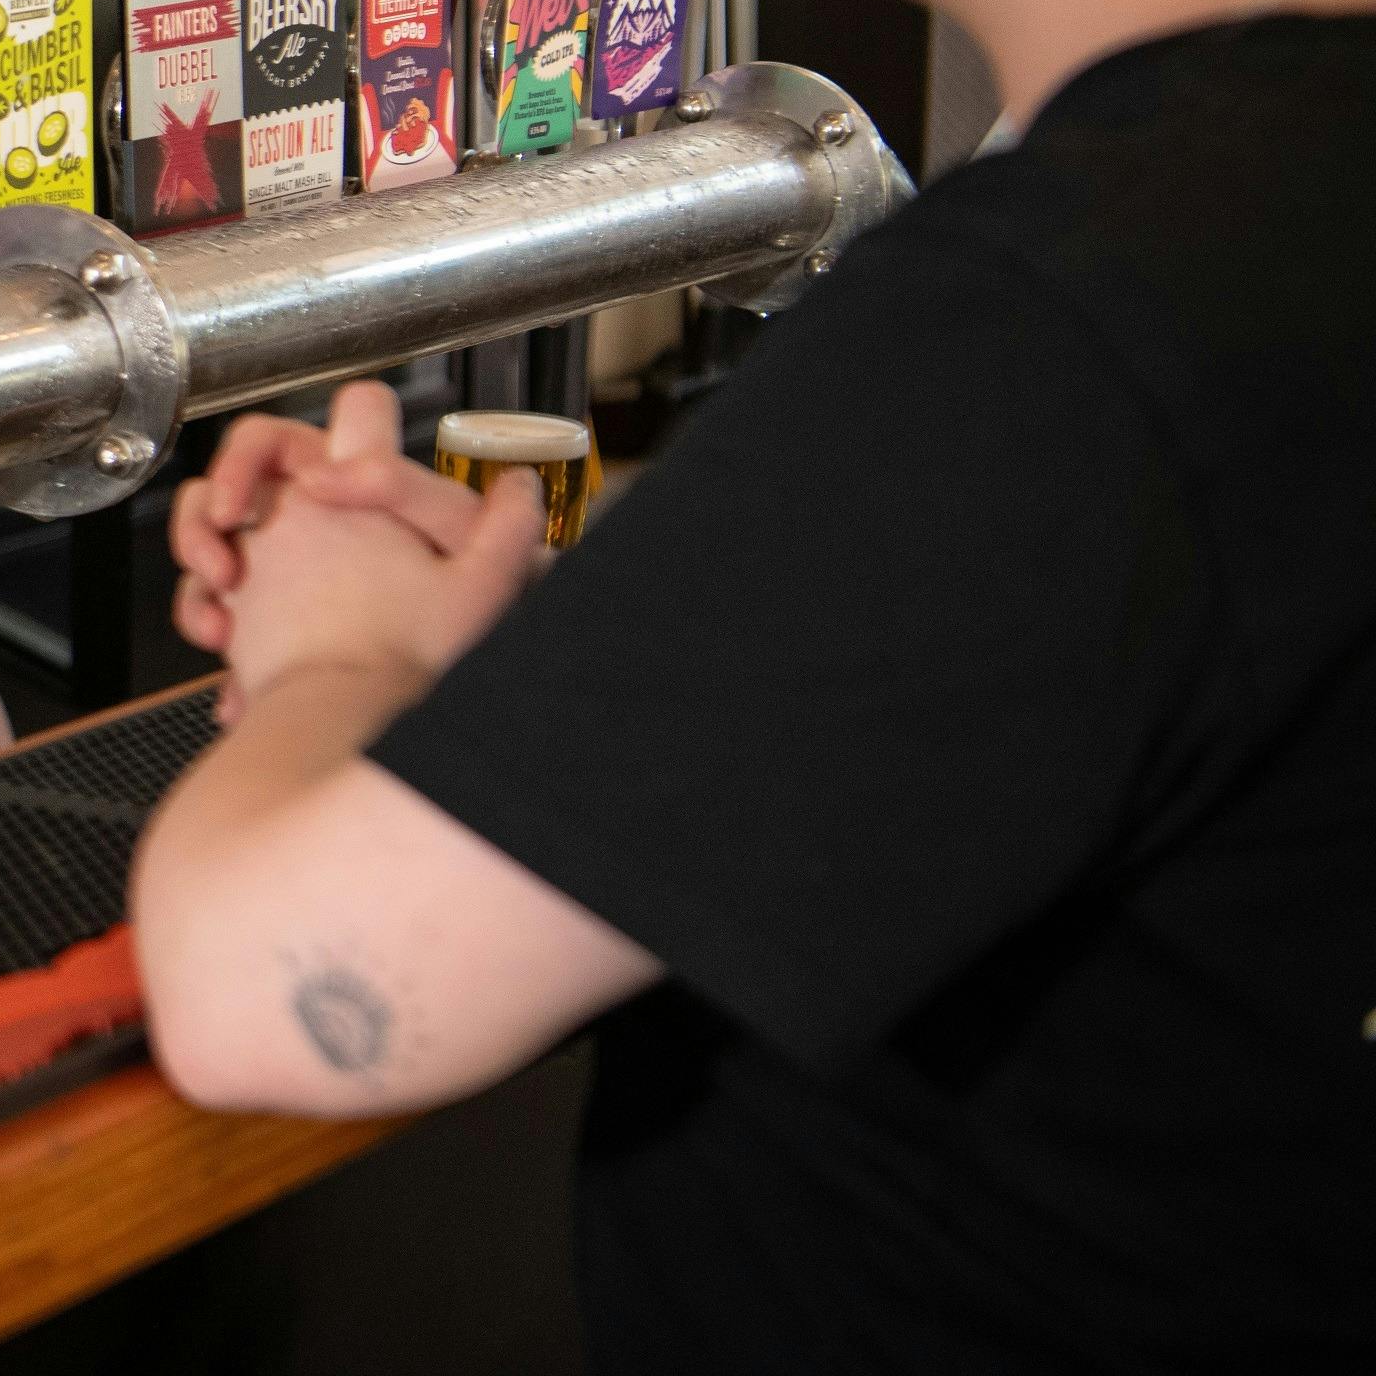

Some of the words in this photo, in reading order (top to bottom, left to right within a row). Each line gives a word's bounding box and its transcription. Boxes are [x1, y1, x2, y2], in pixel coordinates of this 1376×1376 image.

[153, 5, 218, 42] FAINTERS
[272, 32, 306, 64] Ale
[158, 48, 218, 89] DUBBEL
[249, 120, 304, 168] SESSION
[311, 113, 334, 154] ALE
[248, 184, 273, 200] SINGLE
[275, 180, 293, 194] MALT
[295, 175, 316, 188] MASH
[317, 171, 333, 183] BILL
